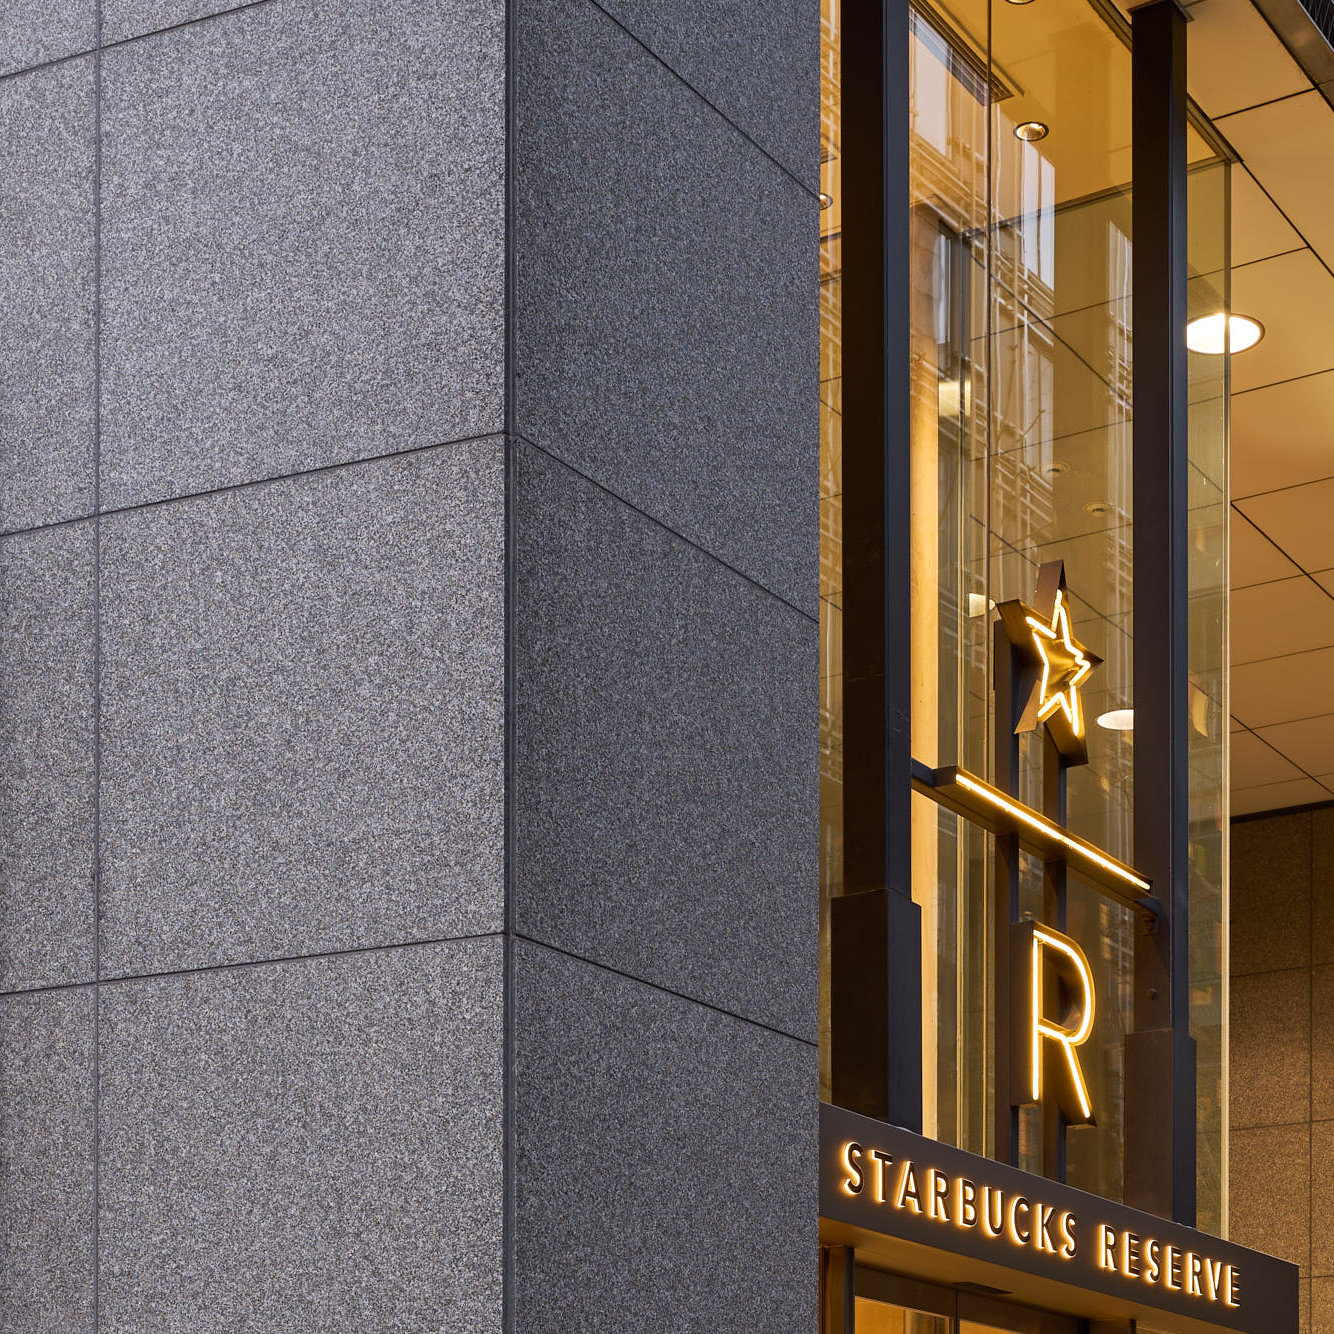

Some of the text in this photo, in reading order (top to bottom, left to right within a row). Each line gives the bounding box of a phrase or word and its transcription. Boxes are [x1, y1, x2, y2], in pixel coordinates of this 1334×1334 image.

[1025, 926, 1095, 1121] R
[842, 1140, 1242, 1308] STARBUCKS RESERVE
